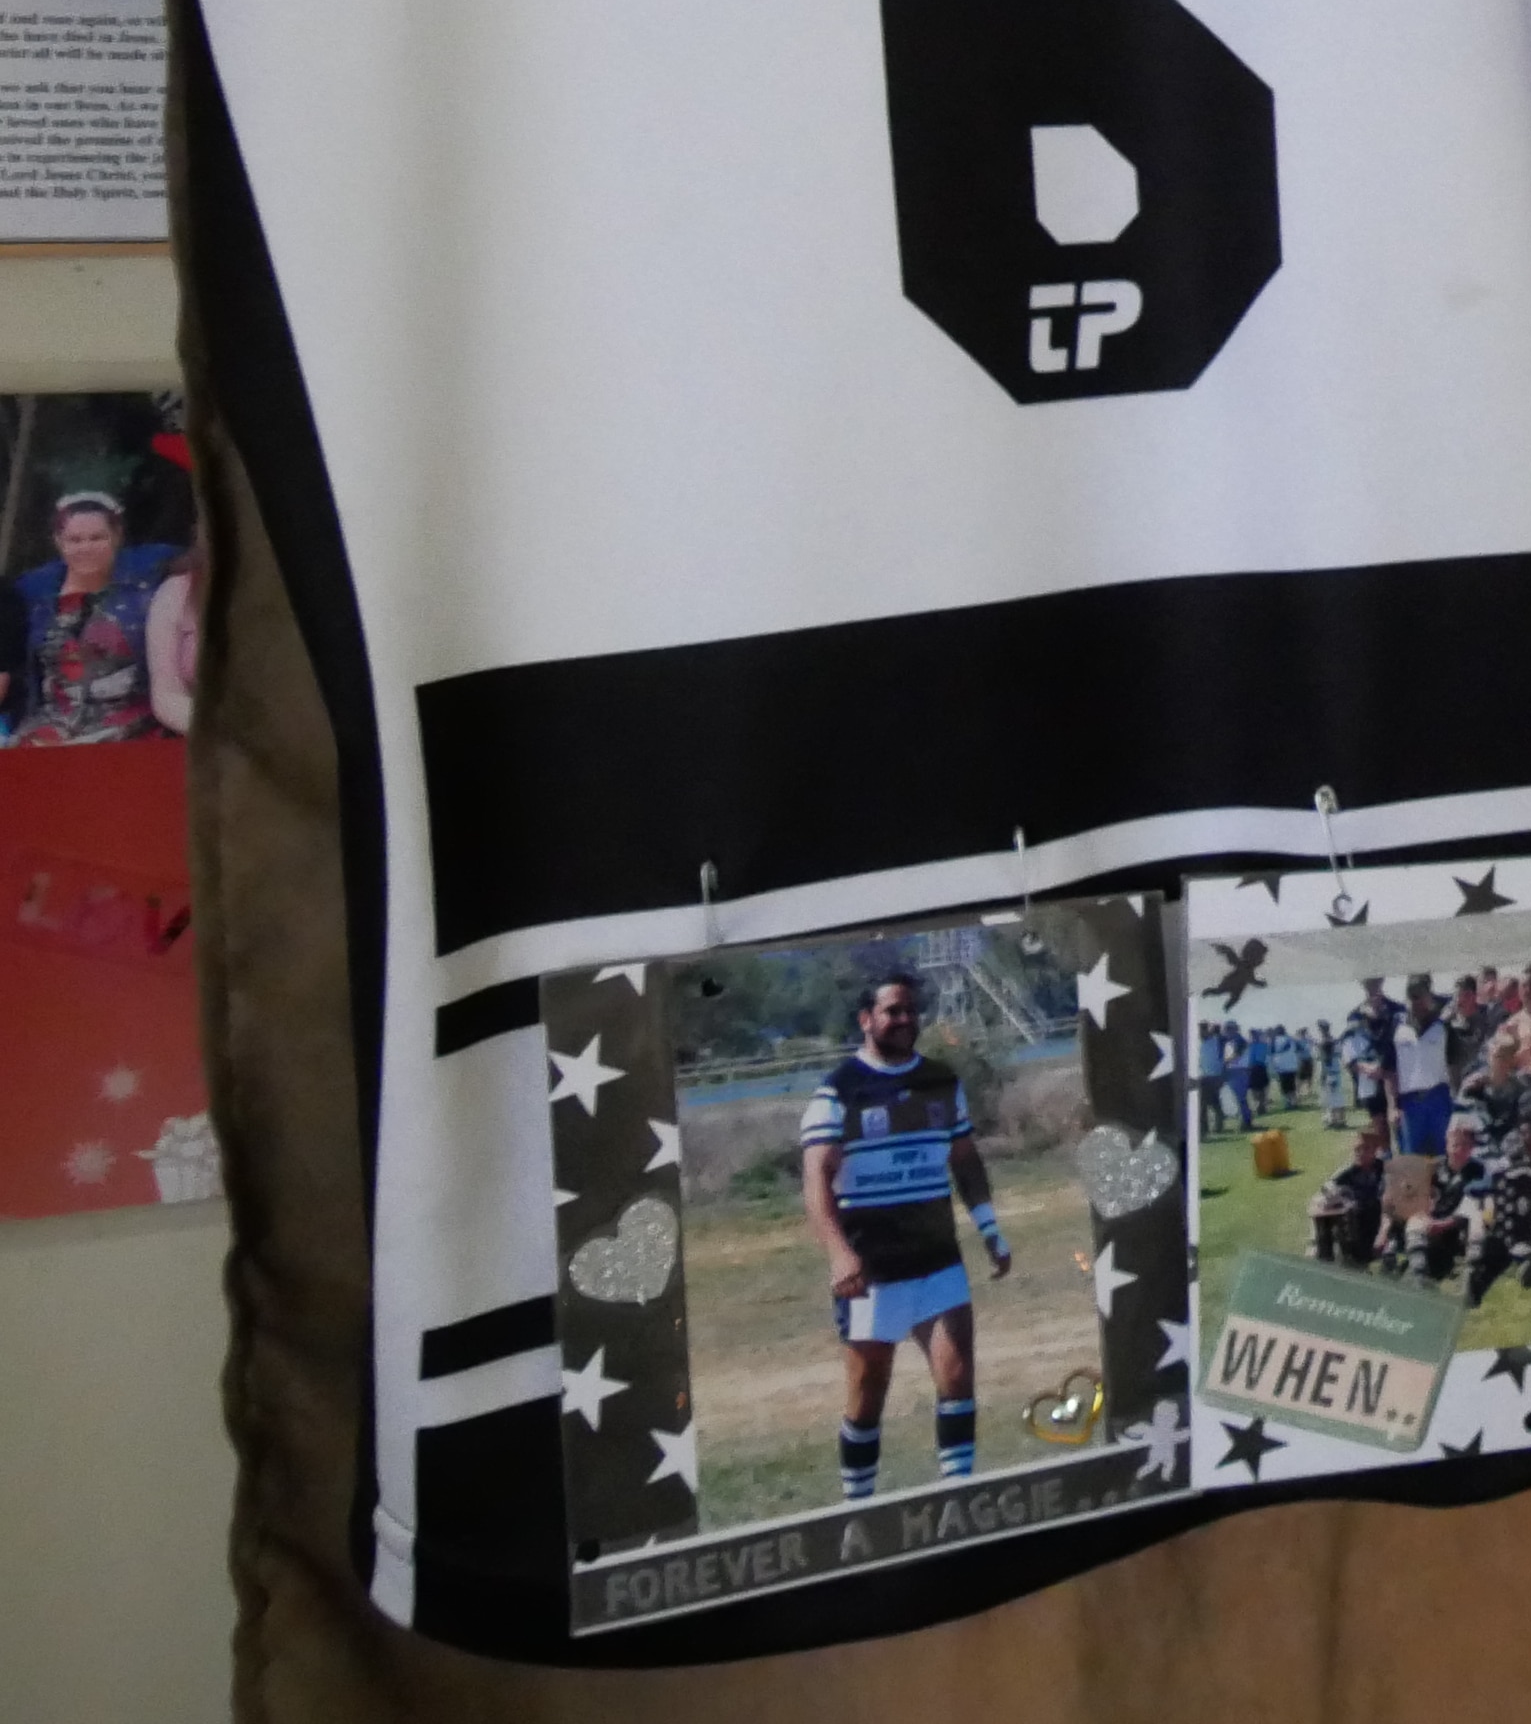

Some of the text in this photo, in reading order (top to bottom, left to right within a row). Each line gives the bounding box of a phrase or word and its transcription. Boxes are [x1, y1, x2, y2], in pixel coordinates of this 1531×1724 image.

[1276, 1282, 1415, 1336] Remember
[605, 1532, 809, 1617] FOREVER
[839, 1518, 875, 1562] A
